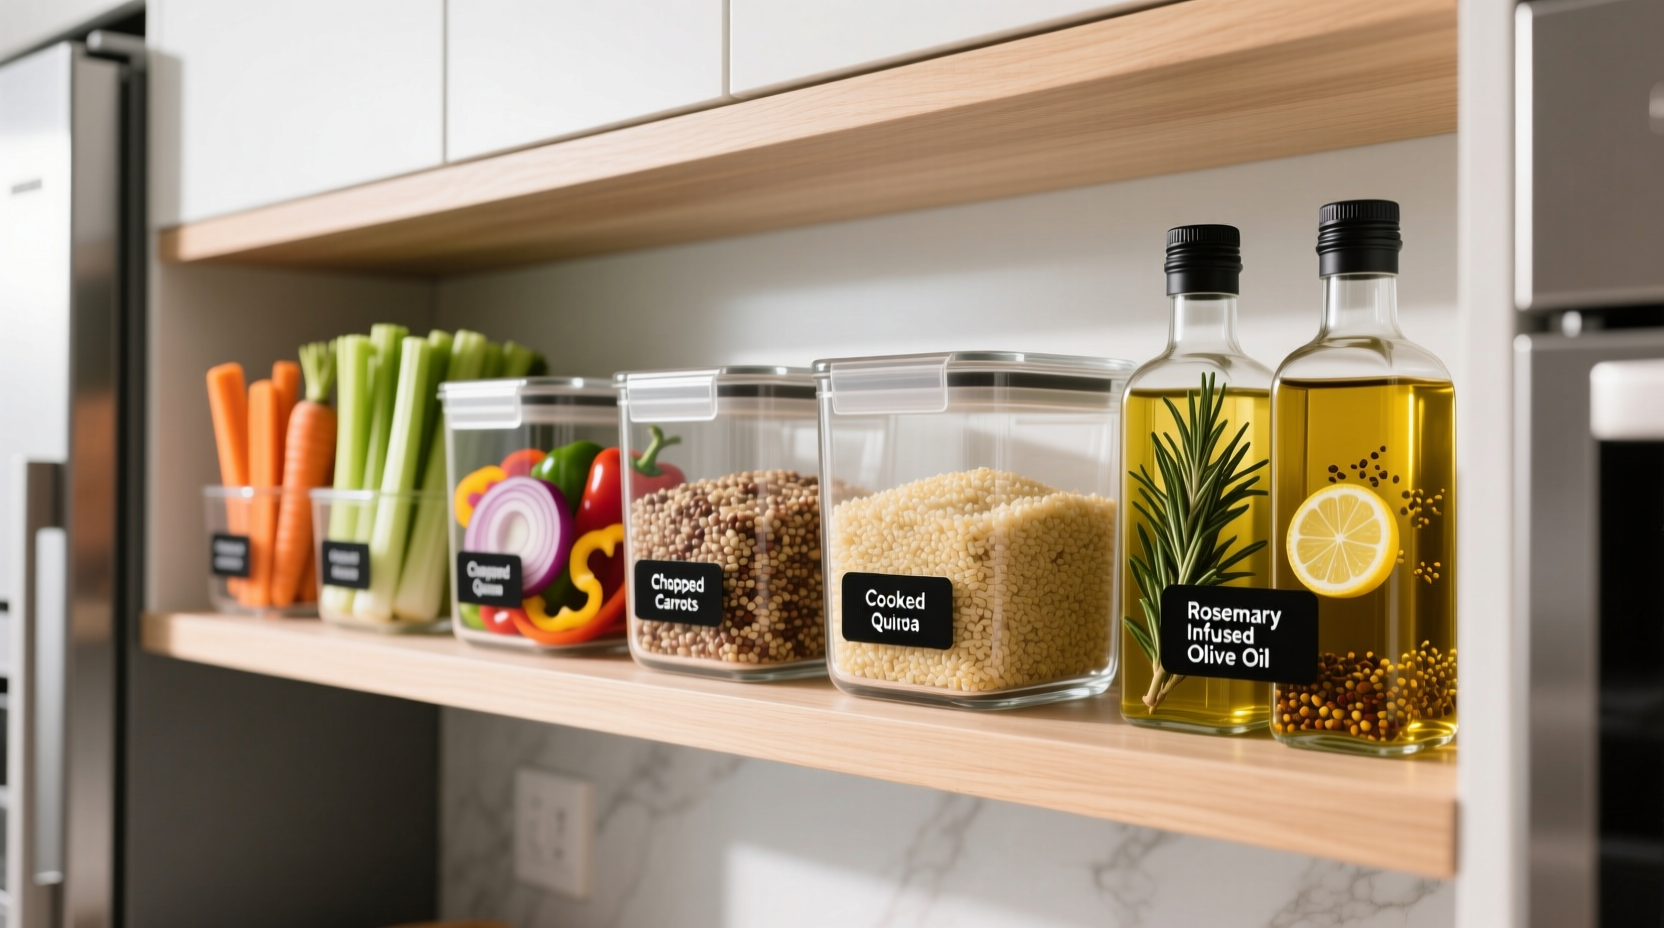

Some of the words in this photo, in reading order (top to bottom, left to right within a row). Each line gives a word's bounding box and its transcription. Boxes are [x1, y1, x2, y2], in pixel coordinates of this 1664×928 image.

[650, 572, 705, 595] Chopped
[654, 593, 699, 612] Carrots
[865, 588, 926, 610] Cooked
[1187, 600, 1282, 631] Rosemary
[1187, 621, 1255, 645] Infused
[1187, 644, 1237, 666] Olive
[1242, 647, 1270, 669] Oil
